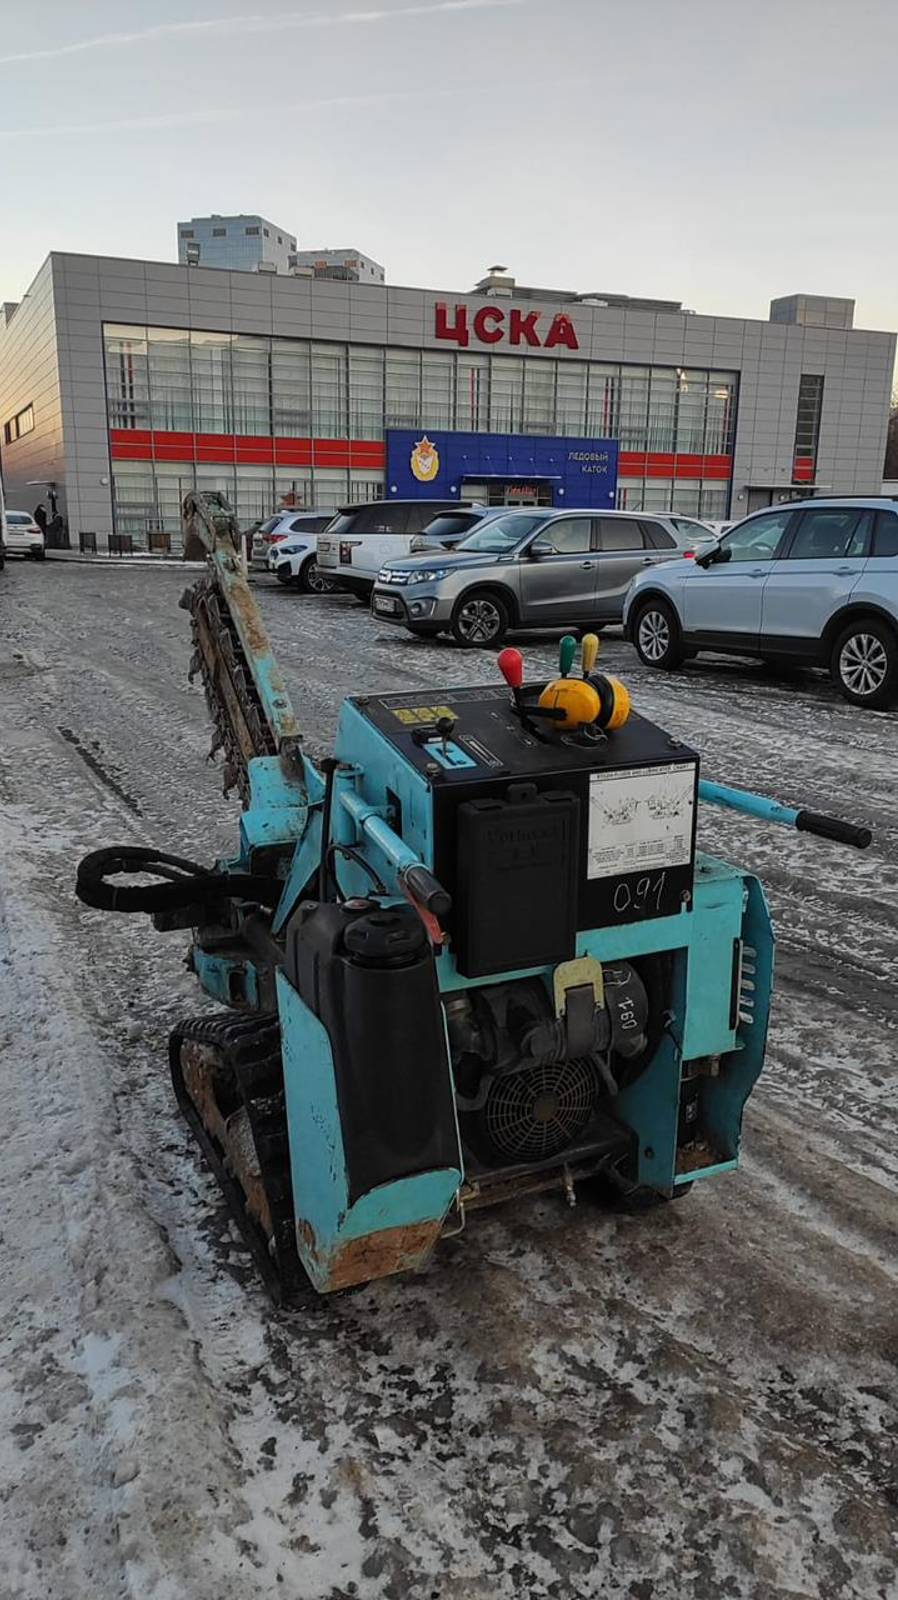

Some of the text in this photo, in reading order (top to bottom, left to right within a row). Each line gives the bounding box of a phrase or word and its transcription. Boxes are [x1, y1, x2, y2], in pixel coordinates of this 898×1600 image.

[434, 302, 579, 349] ЦСКА
[568, 451, 609, 462] ЛЕДОВЫЙ
[582, 465, 608, 474] КАТОК
